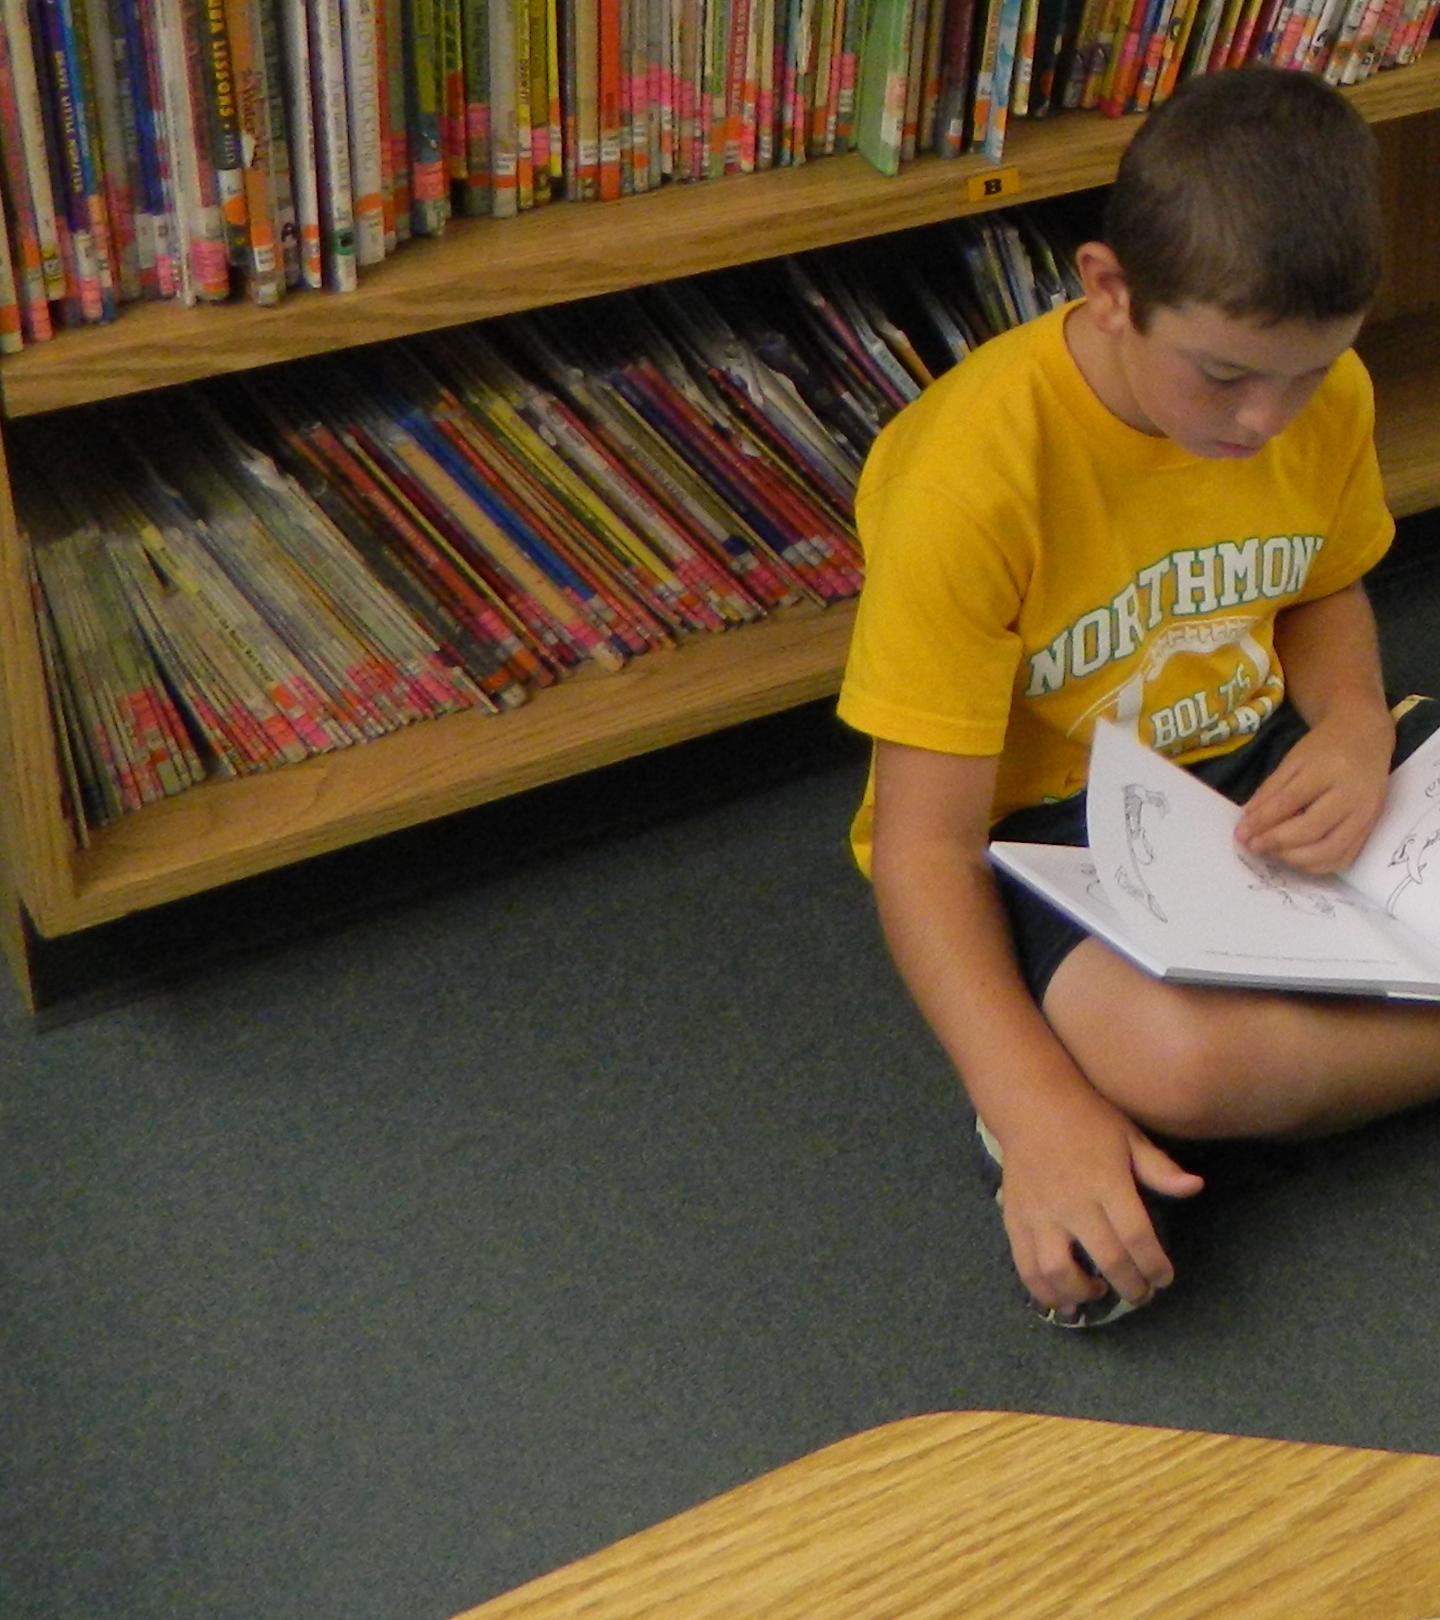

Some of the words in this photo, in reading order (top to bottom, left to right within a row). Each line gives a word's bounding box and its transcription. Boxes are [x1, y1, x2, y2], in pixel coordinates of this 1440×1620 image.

[212, 40, 236, 118] LESSONS
[356, 25, 373, 67] LOST
[356, 70, 377, 177] DUCKLING
[983, 179, 1003, 196] B
[1150, 661, 1252, 750] BOLTS
